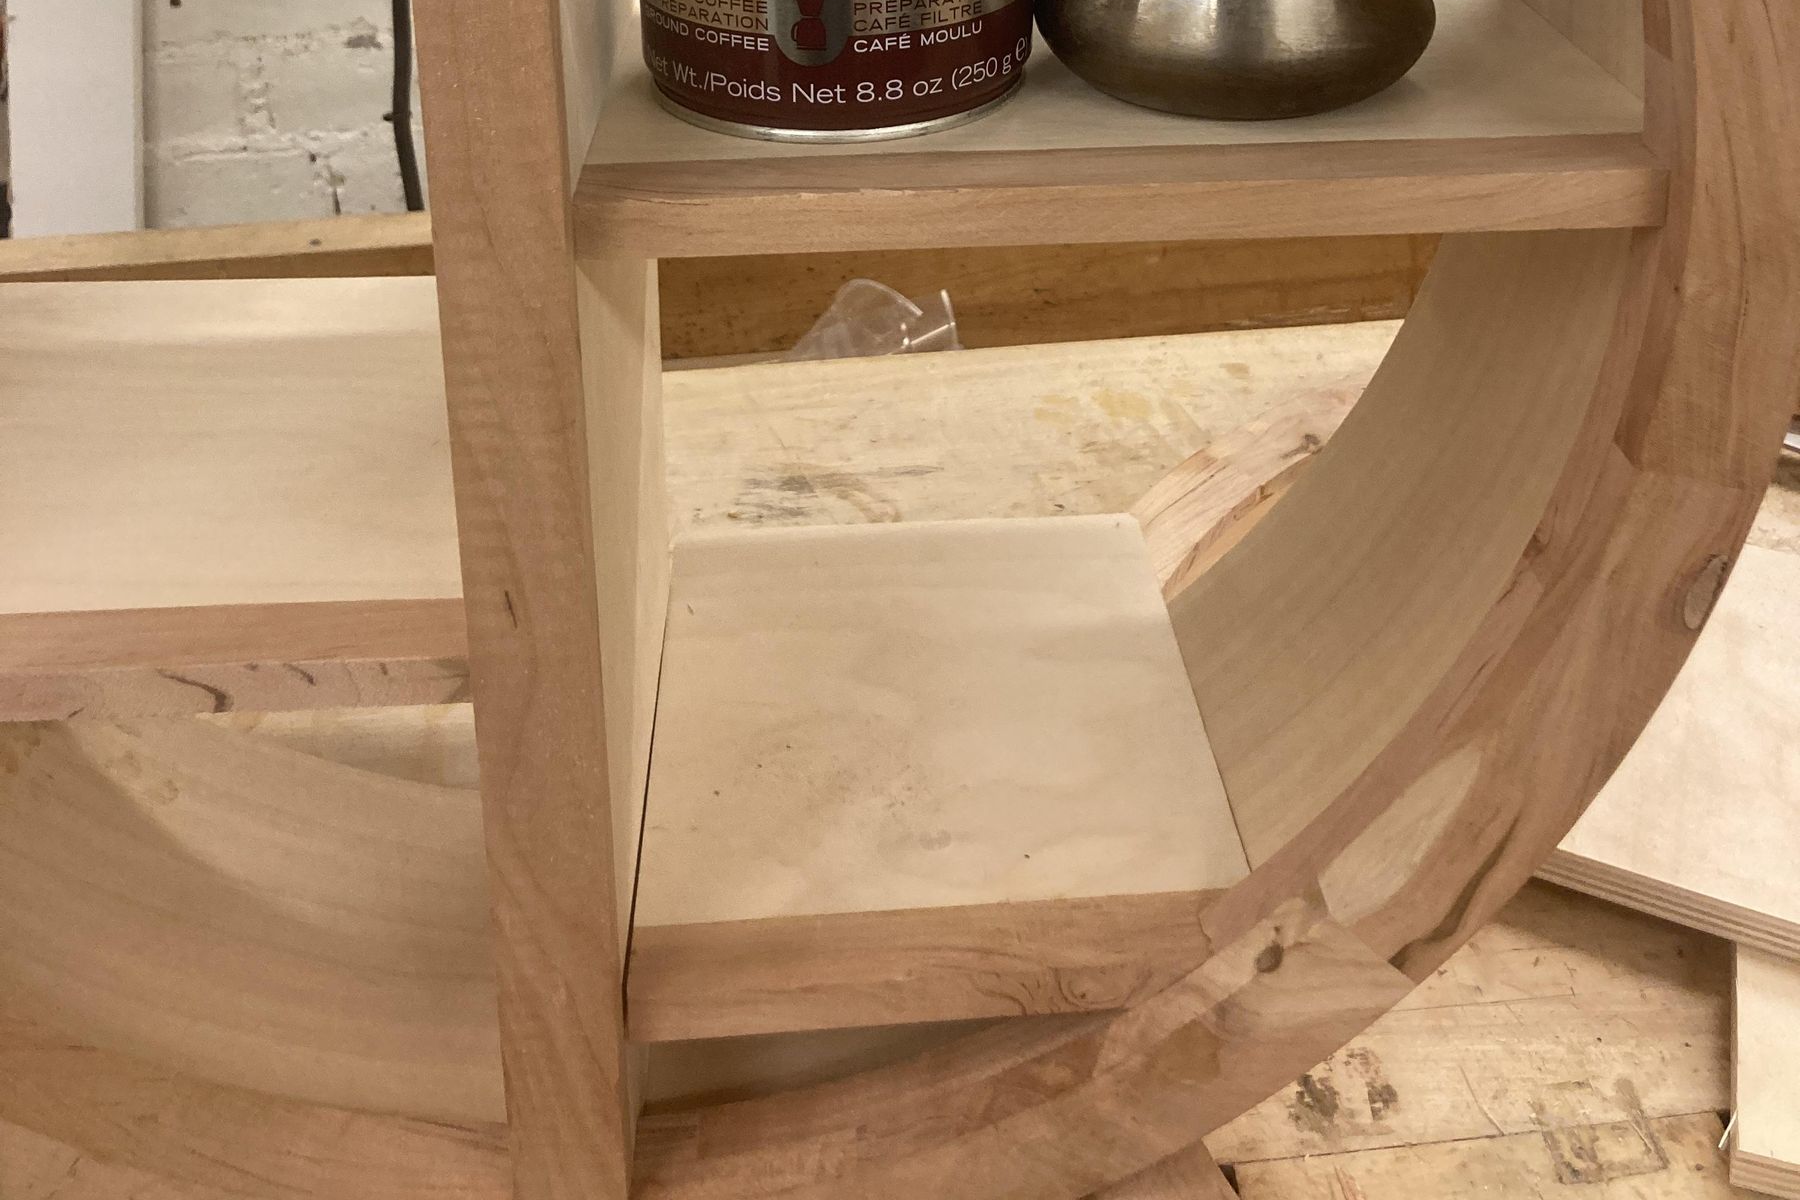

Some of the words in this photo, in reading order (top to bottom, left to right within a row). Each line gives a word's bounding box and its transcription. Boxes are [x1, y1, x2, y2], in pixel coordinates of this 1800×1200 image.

[853, 15, 911, 33] CAFÉ
[920, 0, 983, 26] FILTRE
[695, 27, 770, 52] COFFEE
[853, 33, 912, 53] CAFÉ
[920, 19, 983, 47] MOULU
[792, 83, 847, 104] Net
[855, 79, 904, 103] 8.8
[912, 77, 944, 97] oz
[951, 56, 998, 91] (250
